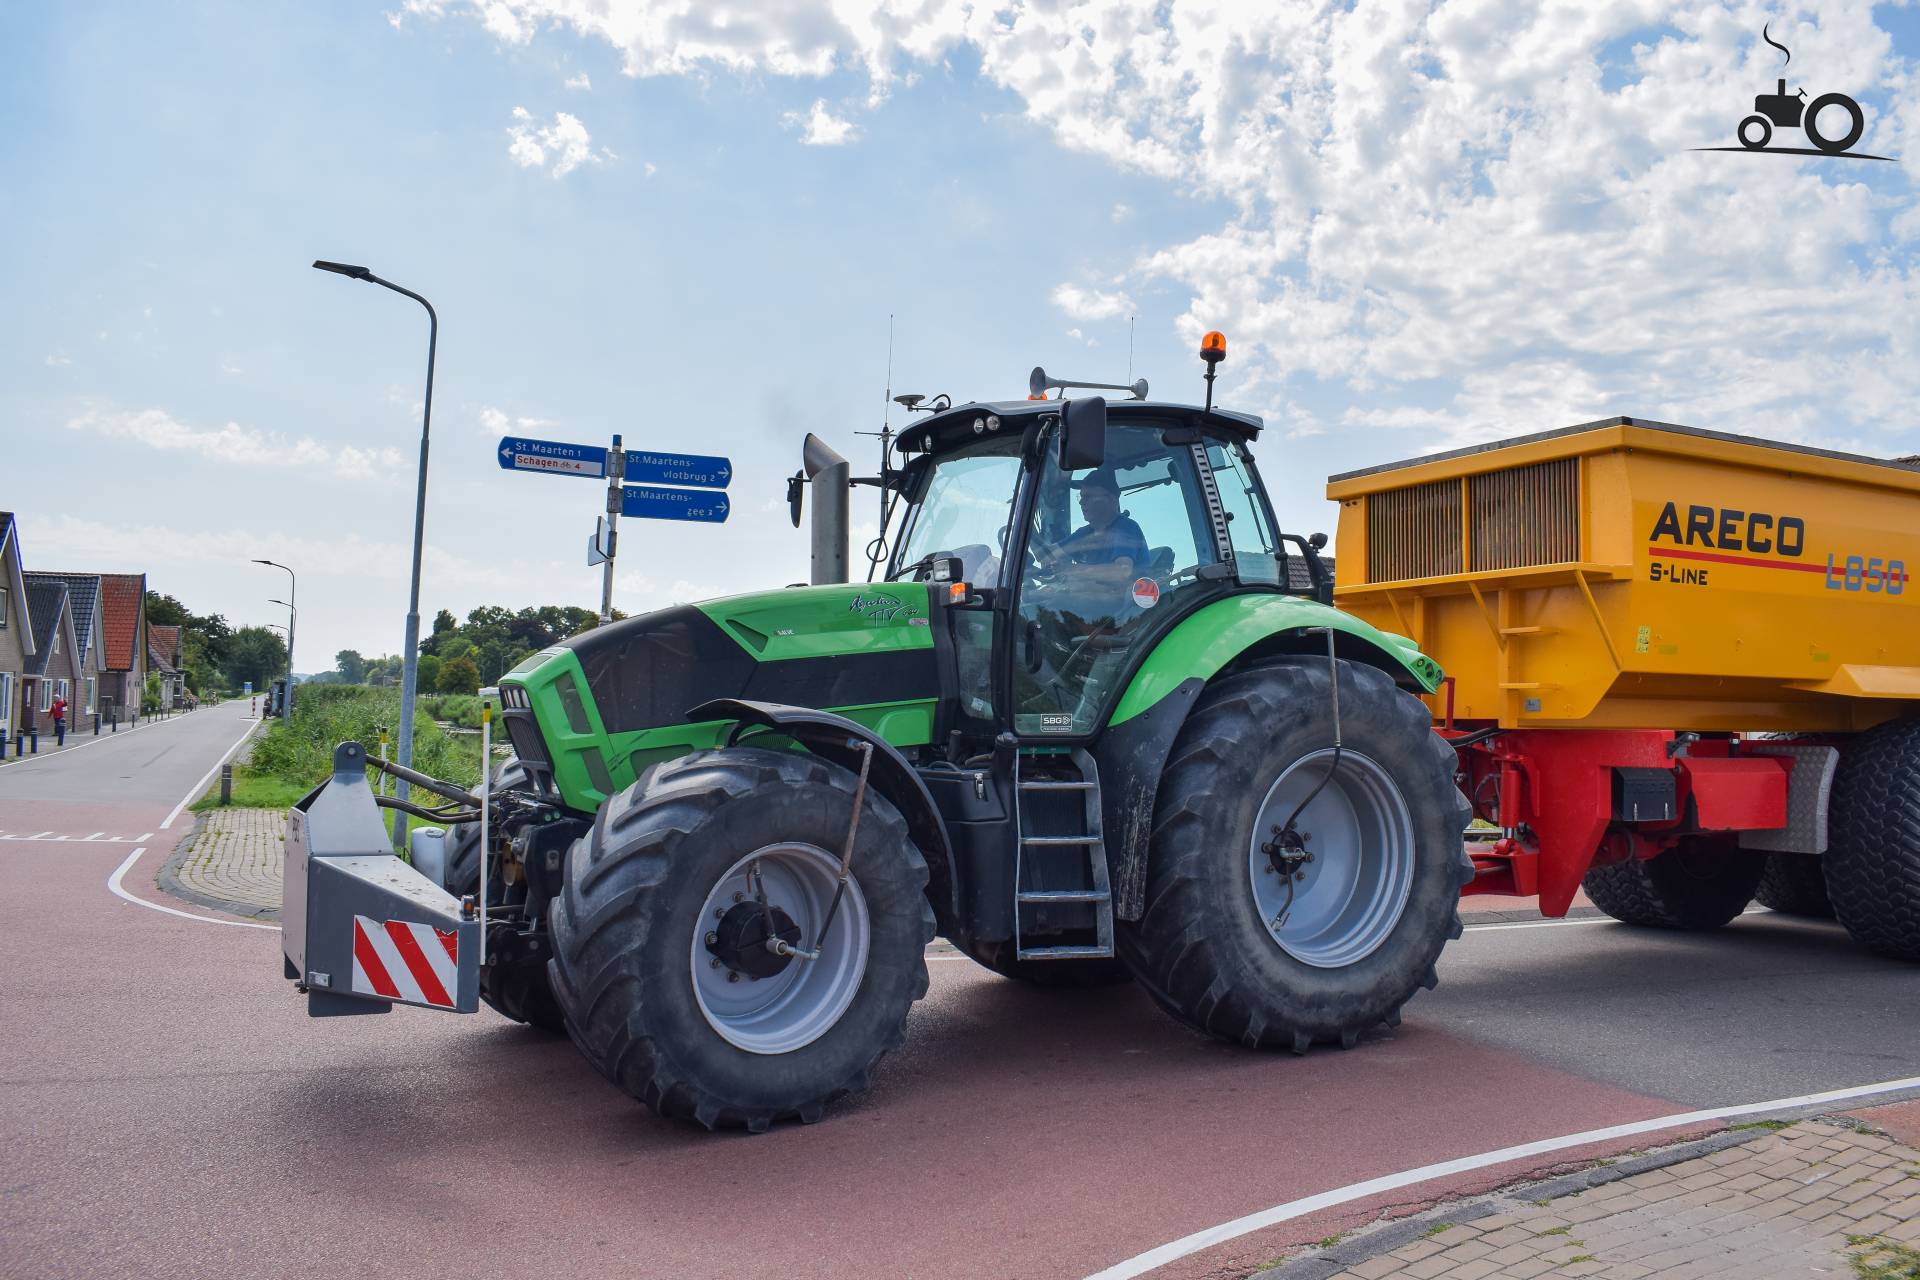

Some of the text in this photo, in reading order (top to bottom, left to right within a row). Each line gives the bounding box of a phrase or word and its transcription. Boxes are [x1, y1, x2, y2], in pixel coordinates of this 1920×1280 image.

[532, 443, 574, 457] Maarten
[517, 455, 559, 468] Schagen
[663, 470, 715, 483] vlotbrug 2
[687, 508, 704, 517] zee
[1649, 501, 1805, 557] ARECO
[1825, 553, 1905, 596] L850
[1136, 579, 1159, 601] 24
